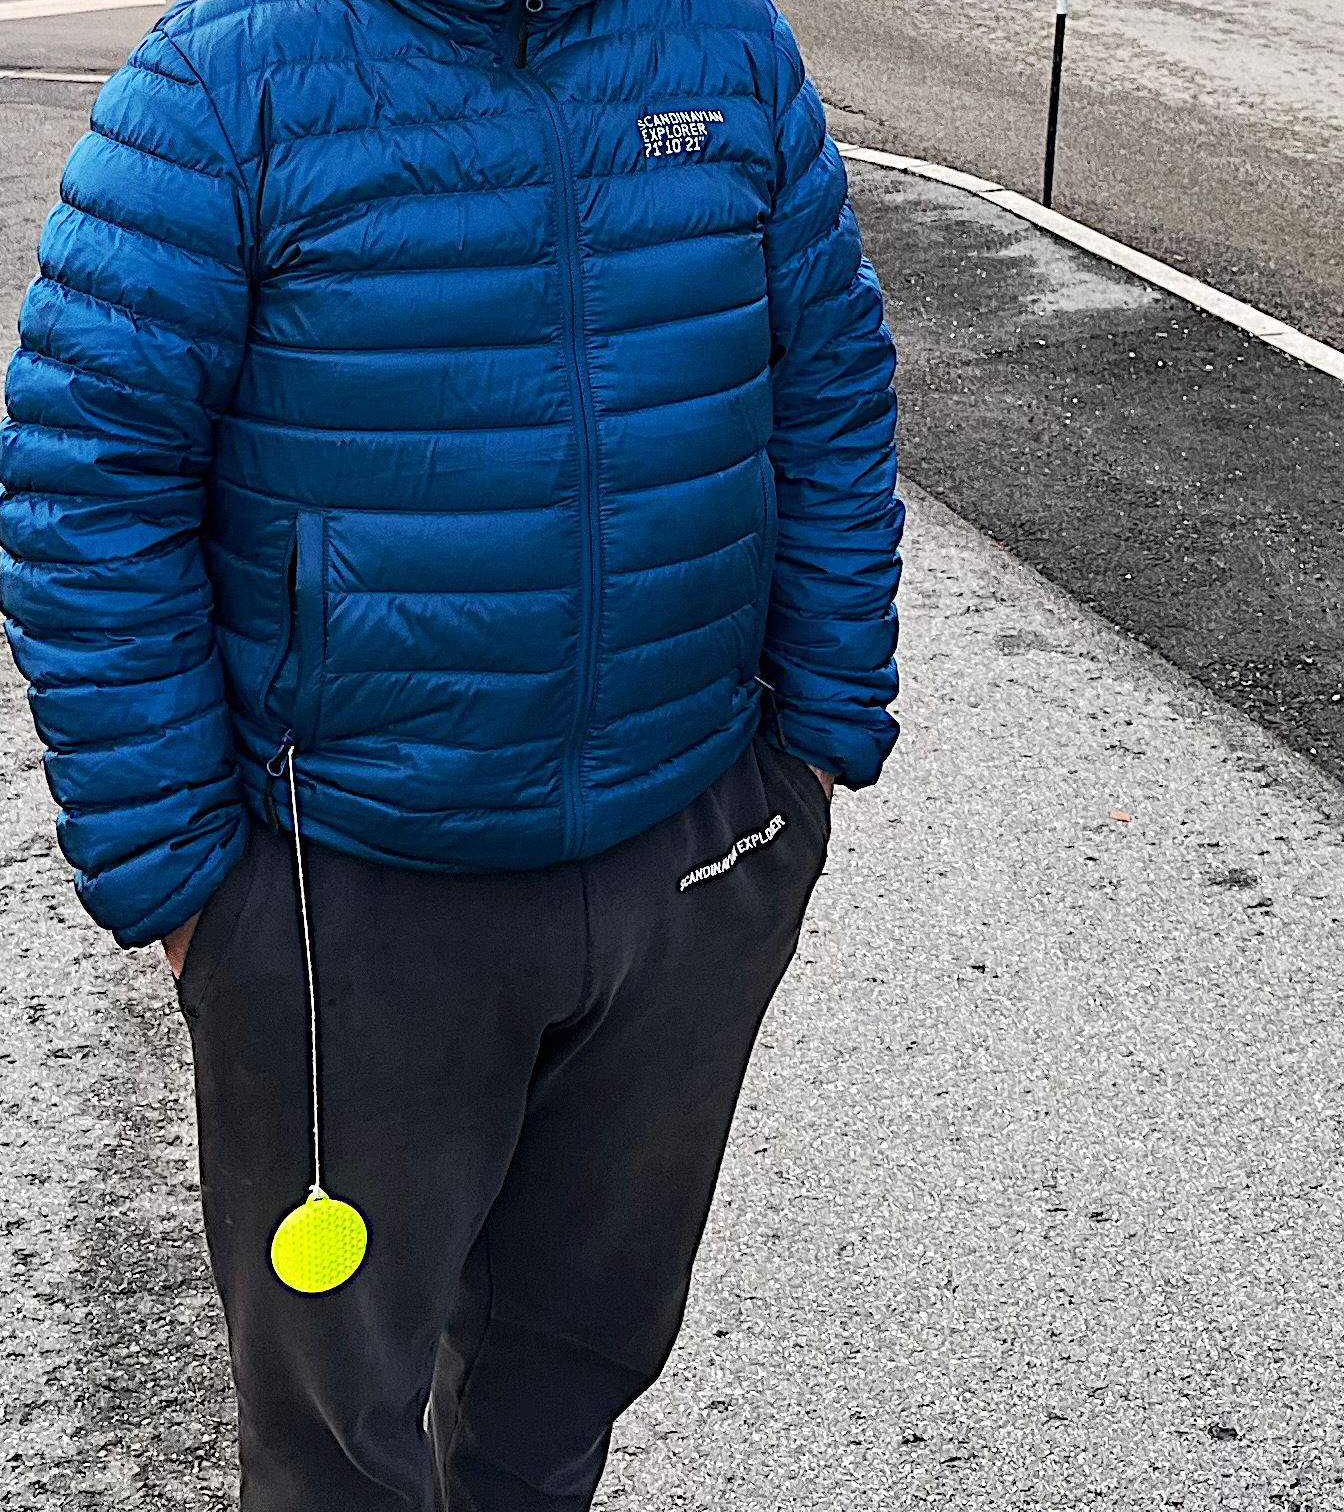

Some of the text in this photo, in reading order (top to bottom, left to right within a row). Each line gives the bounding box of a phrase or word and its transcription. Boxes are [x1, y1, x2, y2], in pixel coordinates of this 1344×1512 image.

[637, 110, 724, 130] SCANDINAVIAN
[641, 123, 708, 143] EXPLORER
[679, 844, 738, 892] SCANDINAV
